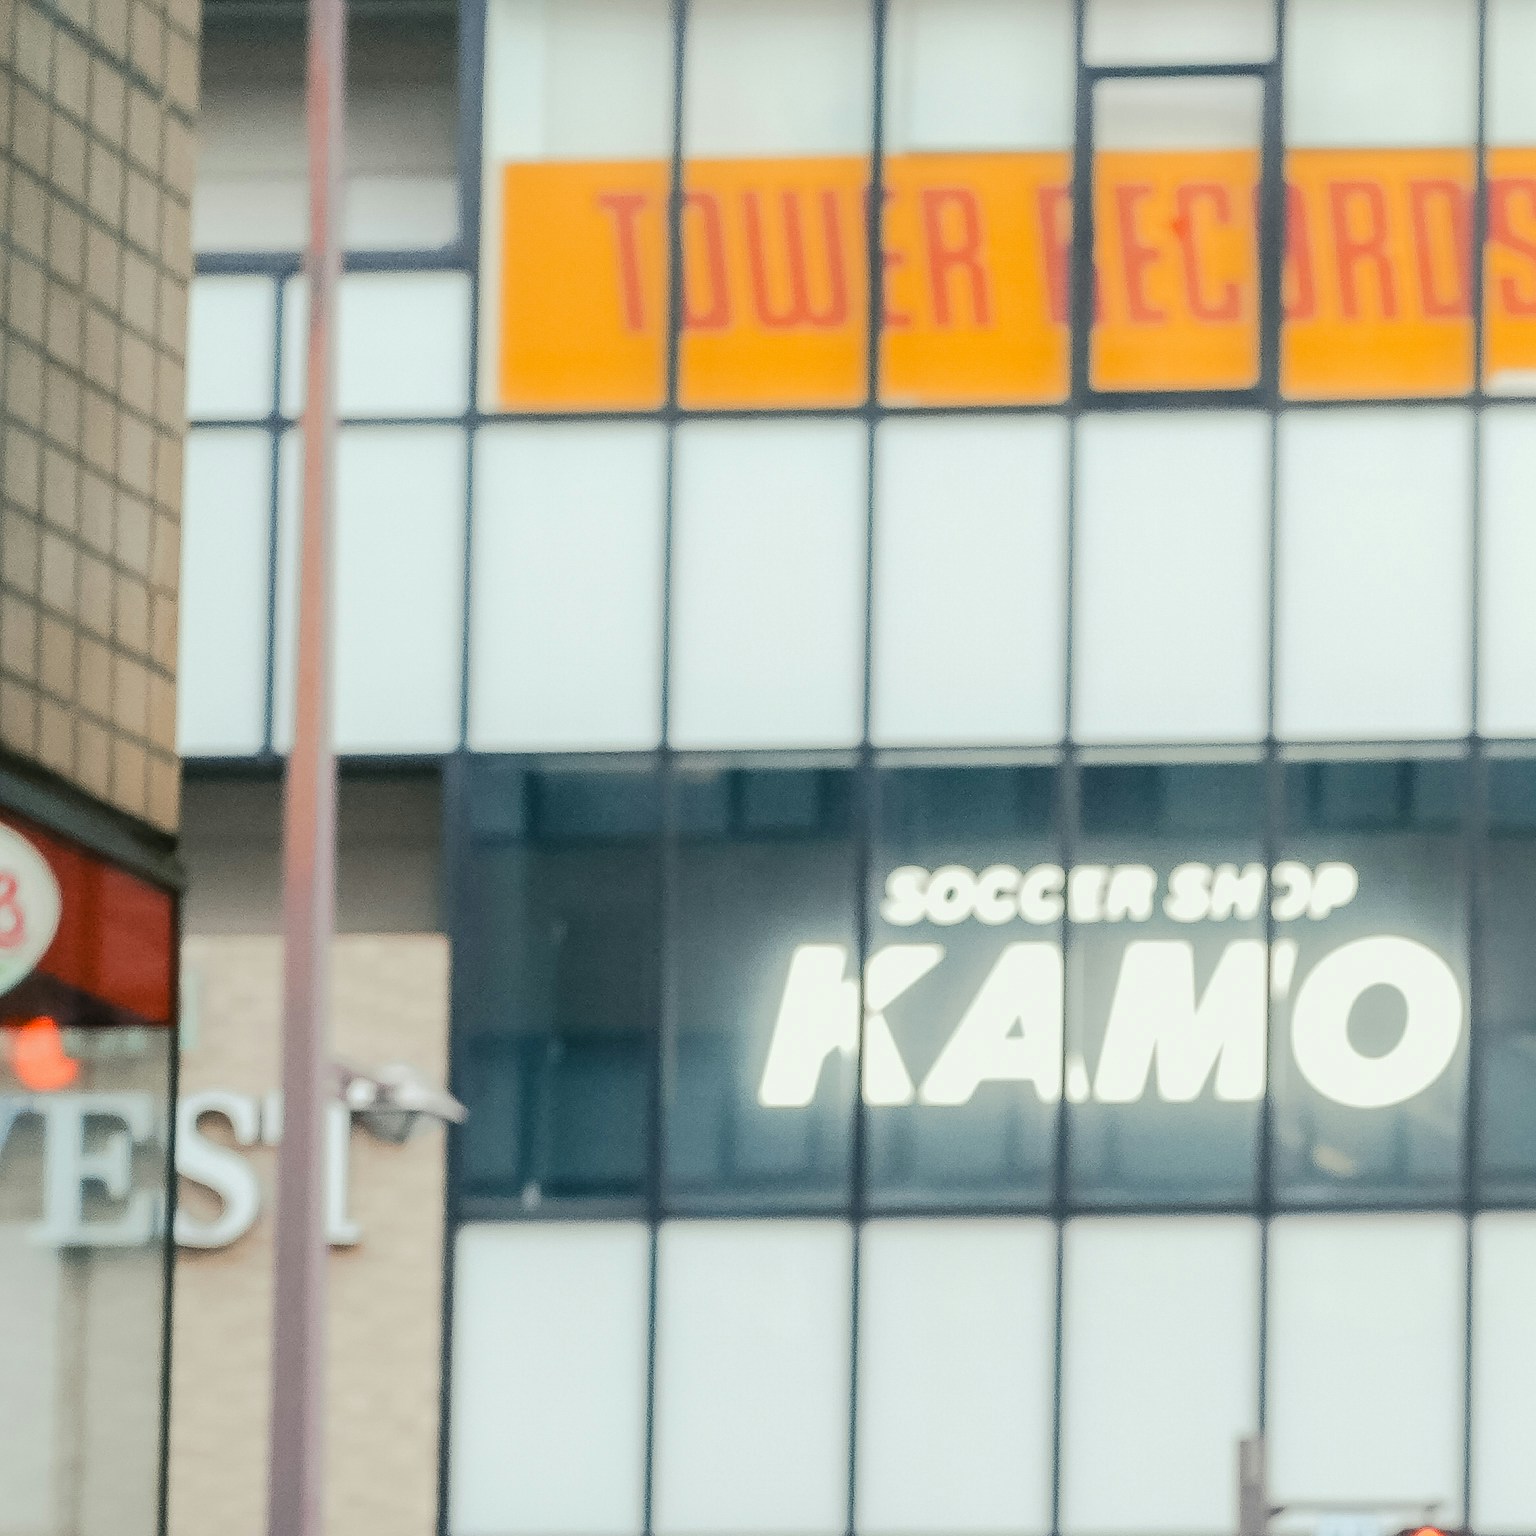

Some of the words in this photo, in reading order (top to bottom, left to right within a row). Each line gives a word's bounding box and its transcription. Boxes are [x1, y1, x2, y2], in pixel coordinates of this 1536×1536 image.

[592, 185, 994, 333] TOWER
[880, 861, 1158, 926] SOCCER
[1164, 860, 1359, 923] SHOP
[757, 935, 1462, 1107] KAMO
